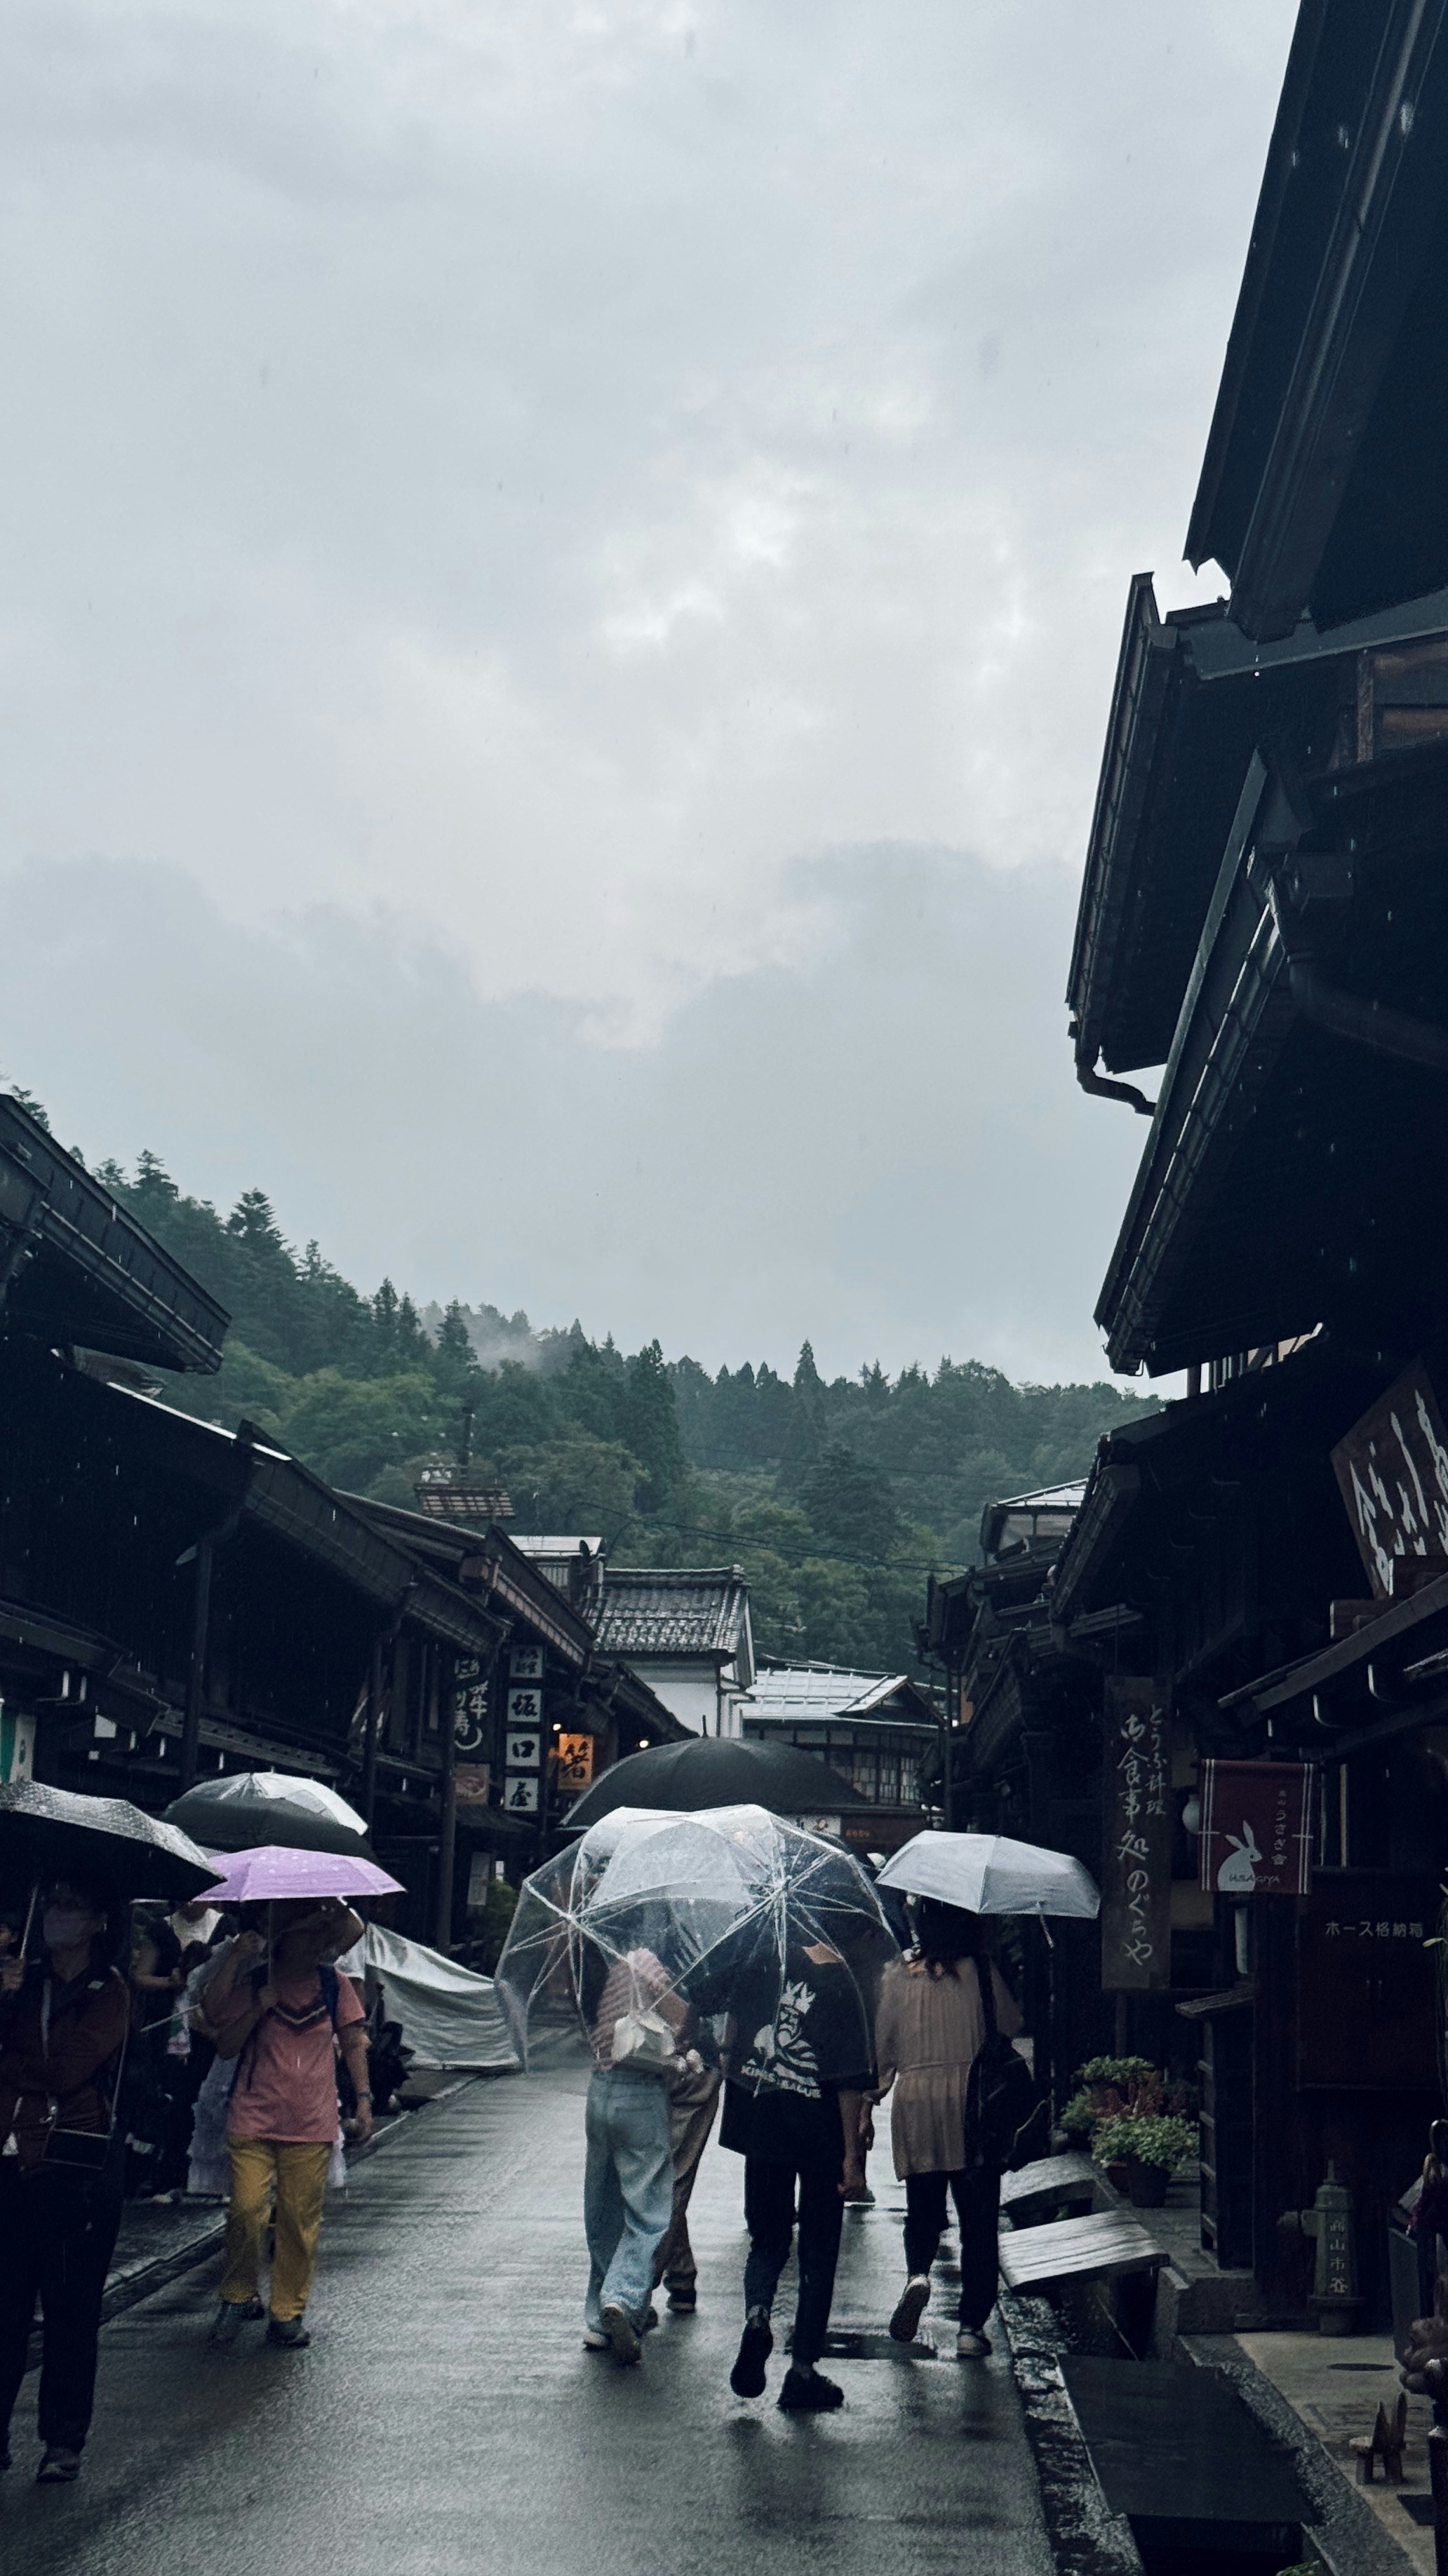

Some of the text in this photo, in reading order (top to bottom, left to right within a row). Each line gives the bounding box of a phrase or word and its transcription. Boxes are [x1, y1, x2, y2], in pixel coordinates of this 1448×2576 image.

[1325, 1920, 1423, 1938] ホース格納箱
